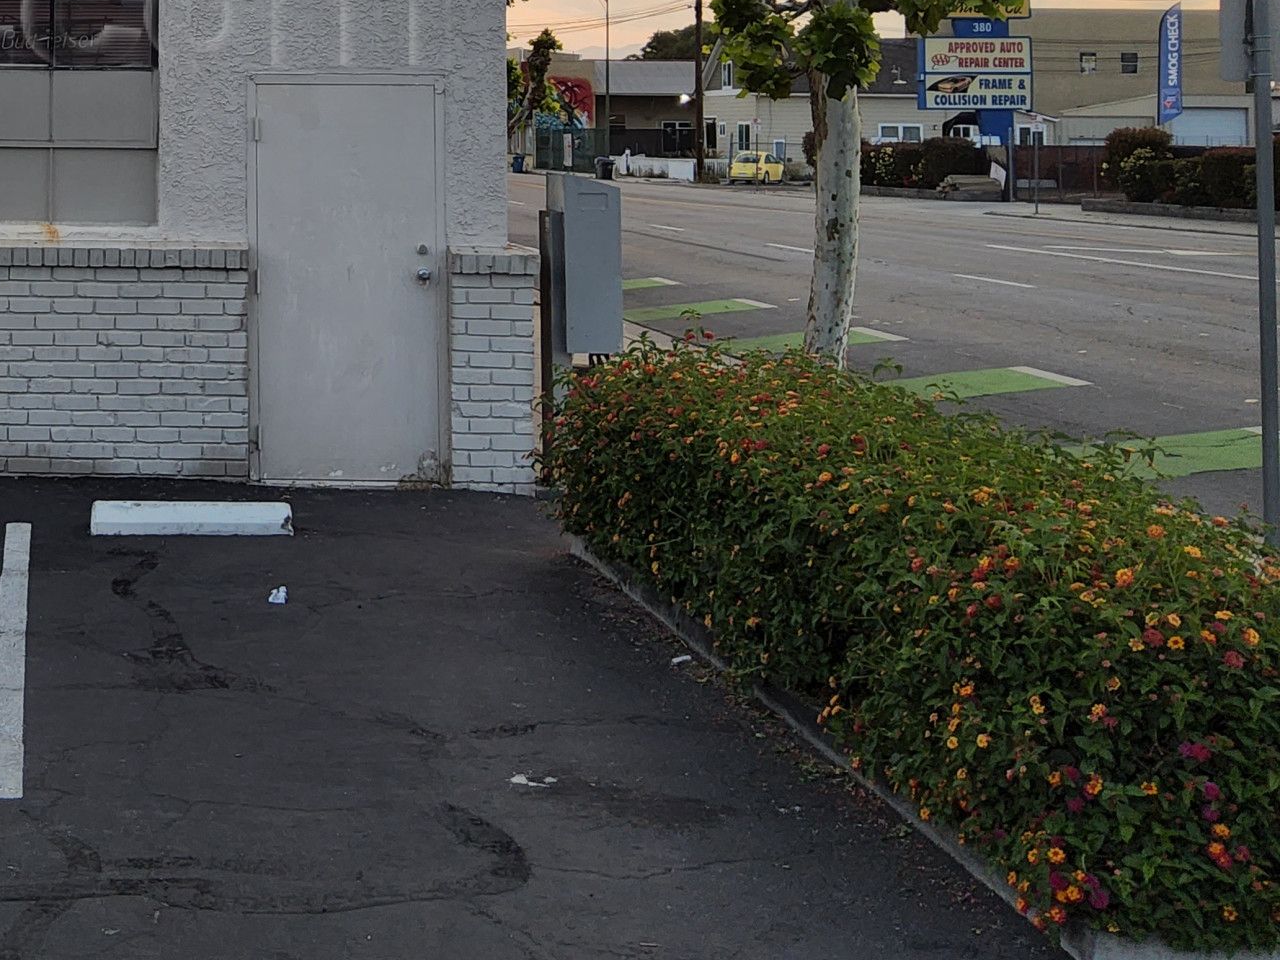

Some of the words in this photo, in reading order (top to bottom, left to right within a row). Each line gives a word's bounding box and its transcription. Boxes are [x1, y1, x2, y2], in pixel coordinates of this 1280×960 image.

[972, 22, 992, 33] 380
[1166, 13, 1180, 51] CHECK
[948, 41, 996, 54] APPROVED
[1000, 41, 1024, 53] AUTO
[958, 57, 990, 68] REPAIR
[992, 57, 1025, 68] CENTER
[1167, 52, 1178, 87] SMOG
[978, 78, 1013, 90] FRAME
[1017, 79, 1027, 90] &
[933, 94, 987, 106] COLLISION
[991, 94, 1027, 106] REPAIR
